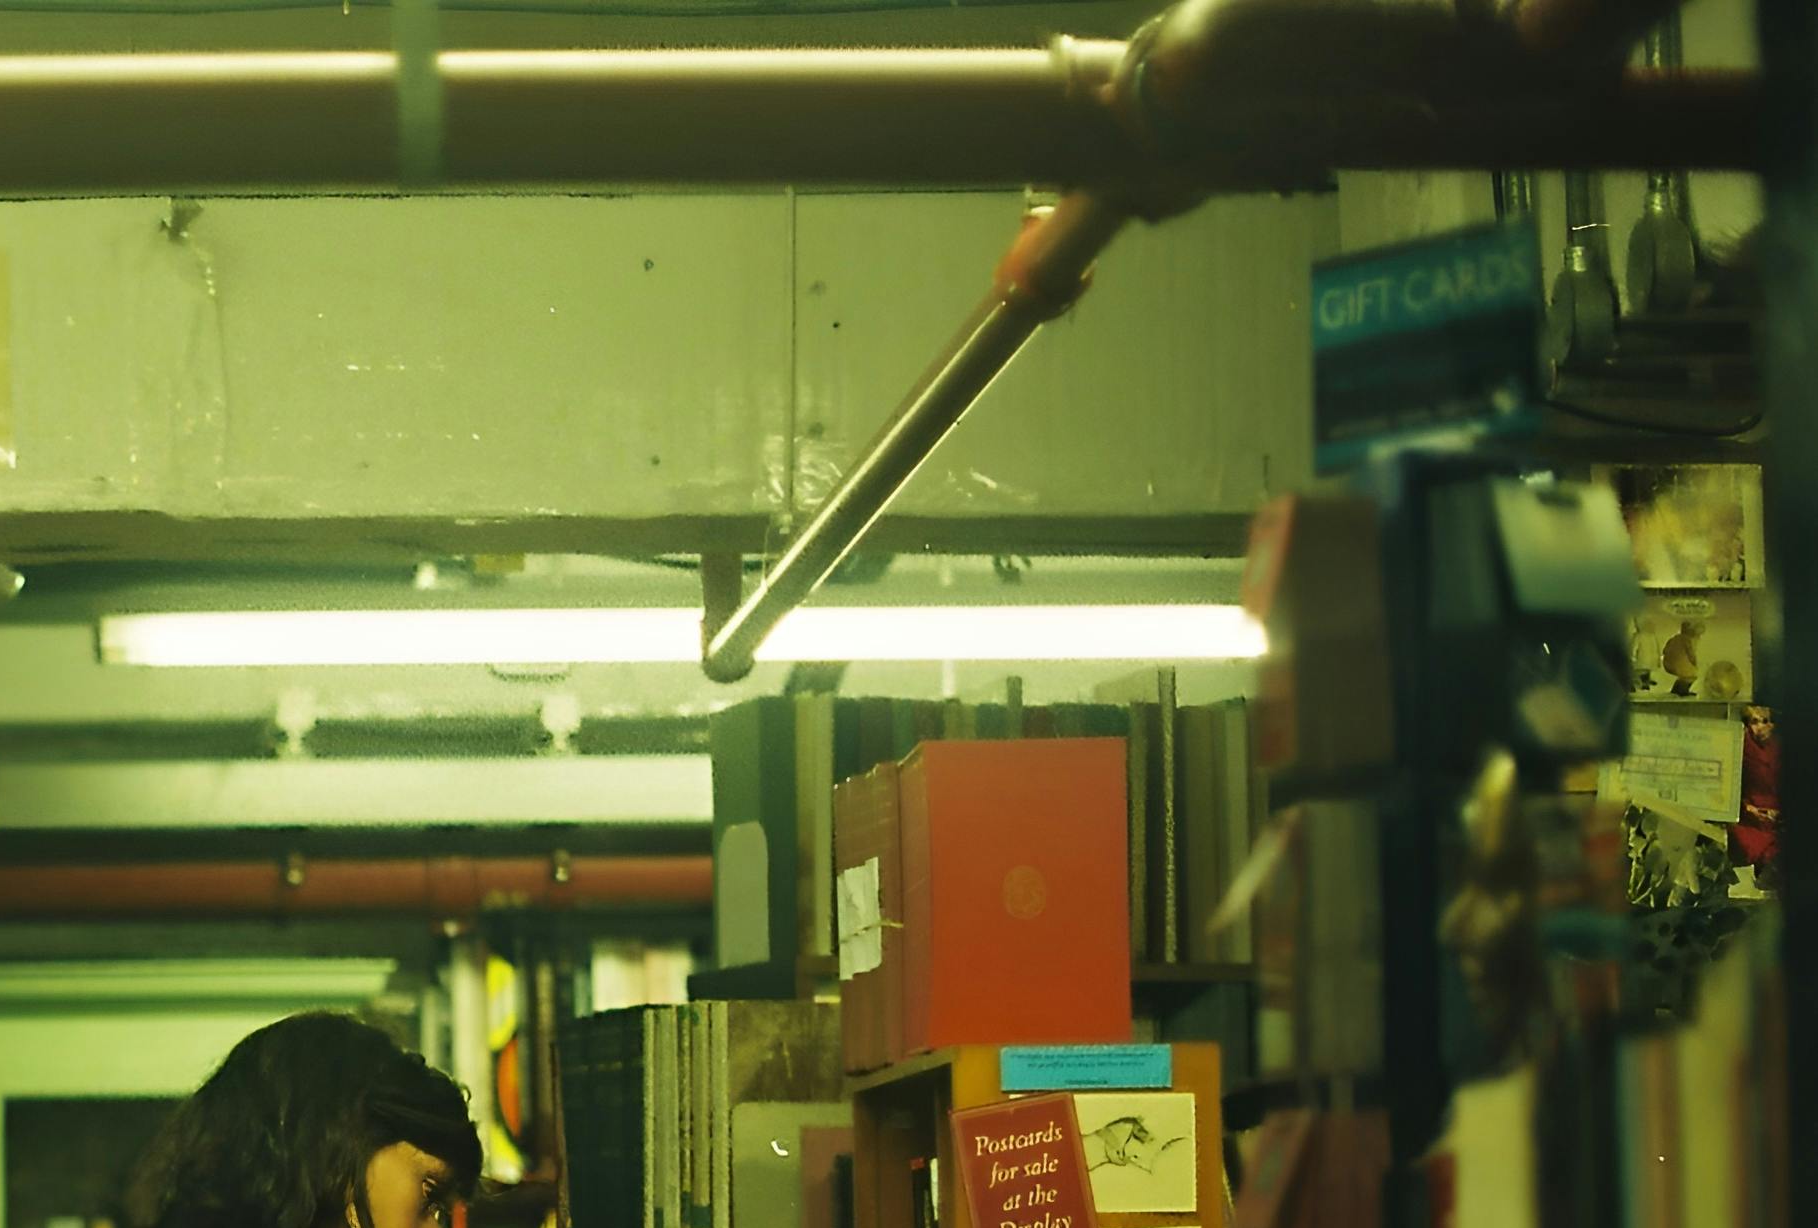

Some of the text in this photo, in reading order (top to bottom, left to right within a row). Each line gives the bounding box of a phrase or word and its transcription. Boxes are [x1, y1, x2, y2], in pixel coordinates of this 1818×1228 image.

[1319, 249, 1533, 330] GIFT CARDS
[975, 1120, 1064, 1157] Postcards
[989, 1154, 1059, 1189] for sale
[1002, 1184, 1058, 1212] at the
